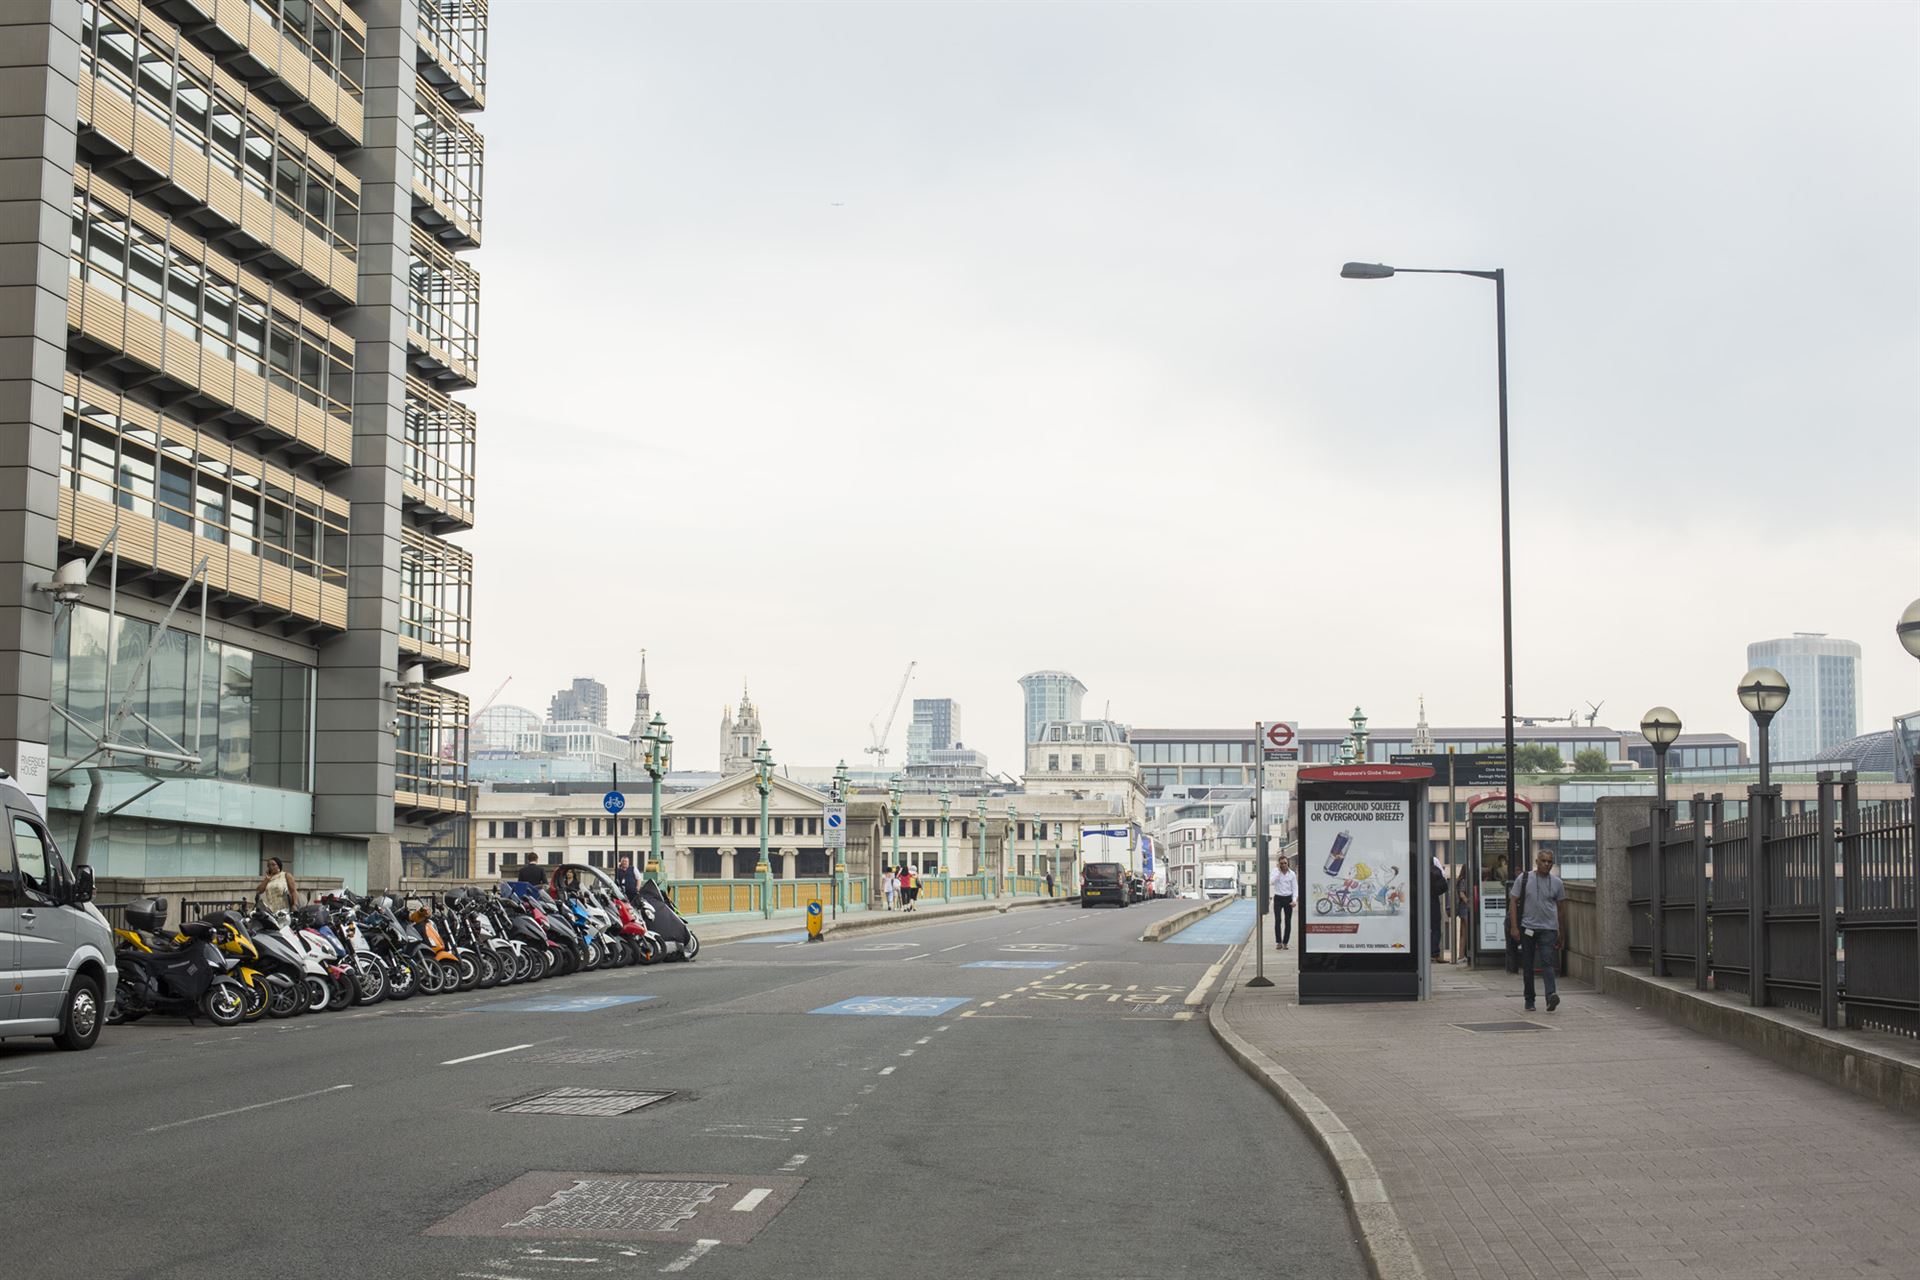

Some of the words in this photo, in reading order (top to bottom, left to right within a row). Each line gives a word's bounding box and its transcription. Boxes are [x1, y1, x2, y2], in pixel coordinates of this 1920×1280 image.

[20, 755, 46, 768] RIVERSIDE
[20, 765, 38, 777] HOUSE
[1332, 769, 1367, 777] Shakespeare's
[1314, 801, 1369, 811] UNDERGROUND
[1370, 801, 1401, 811] SQUEEZE
[1310, 812, 1322, 822] OR
[1323, 812, 1374, 822] OVERGROUND
[1375, 812, 1405, 822] BREEZE?
[1031, 983, 1187, 992] STOP
[1027, 992, 1172, 1004] BUS
